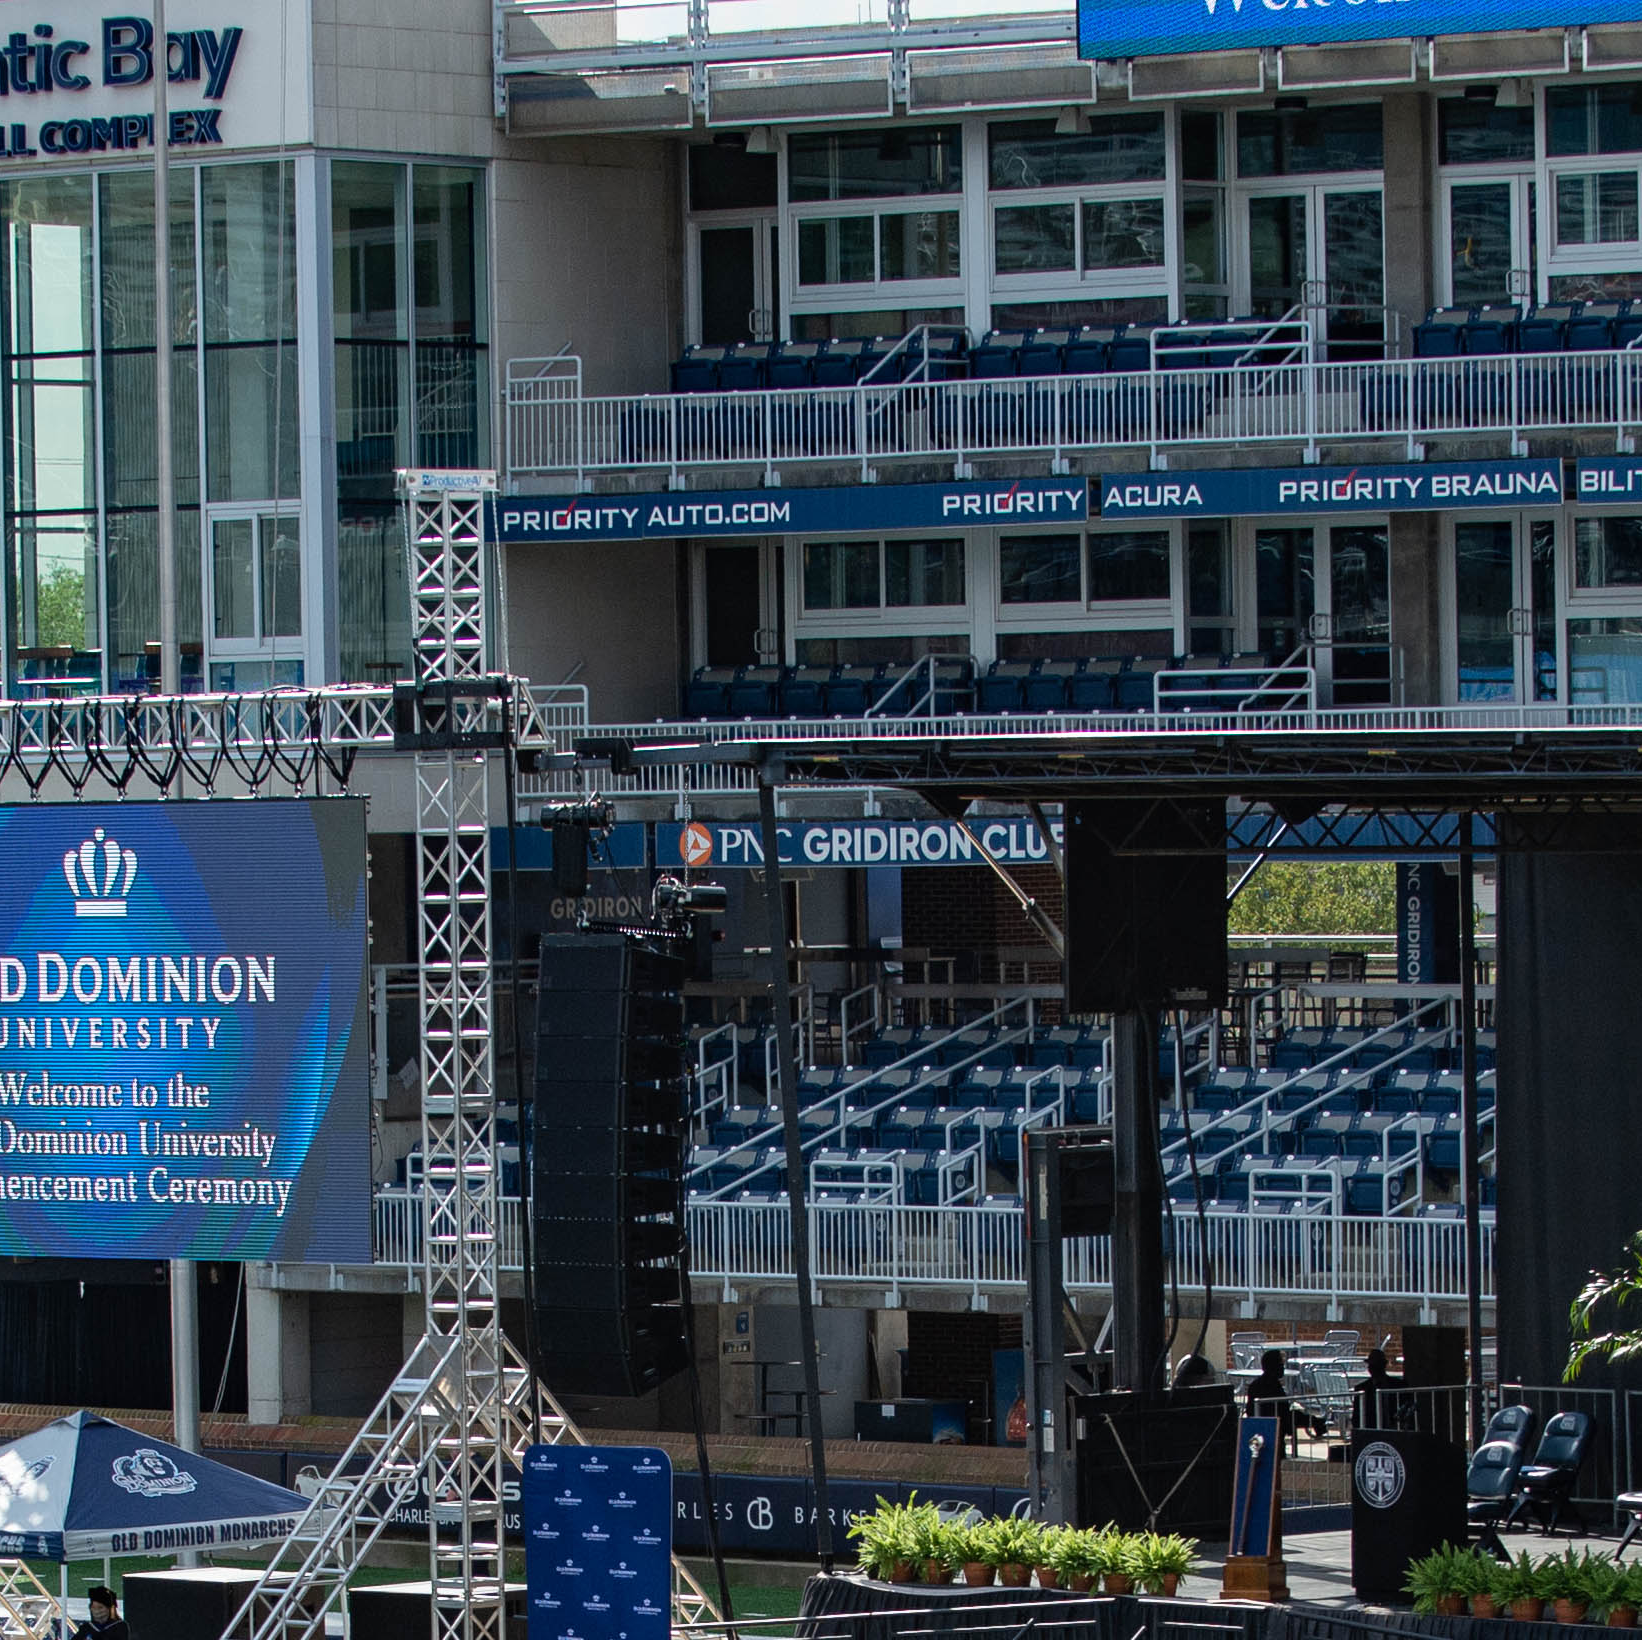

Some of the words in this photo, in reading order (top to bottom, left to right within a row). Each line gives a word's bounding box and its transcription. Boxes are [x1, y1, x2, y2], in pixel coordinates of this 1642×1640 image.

[102, 17, 244, 99] Bay
[943, 490, 1084, 516] PRIORITY
[1104, 484, 1203, 508] ACURA
[1278, 477, 1424, 503] PRIORITY
[503, 506, 640, 532] PRIORITY
[647, 500, 791, 527] AUTO.COM
[803, 826, 972, 863] GRIDIRON
[550, 896, 643, 919] GRDIRON
[37, 953, 277, 1004] DOMINION
[132, 1075, 158, 1109] to
[167, 1073, 209, 1109] the
[140, 1121, 276, 1168] University
[148, 1168, 291, 1217] Ceremony
[112, 1532, 138, 1552] OLD
[144, 1525, 215, 1549] DOMINION
[220, 1518, 296, 1543] MONARCHS
